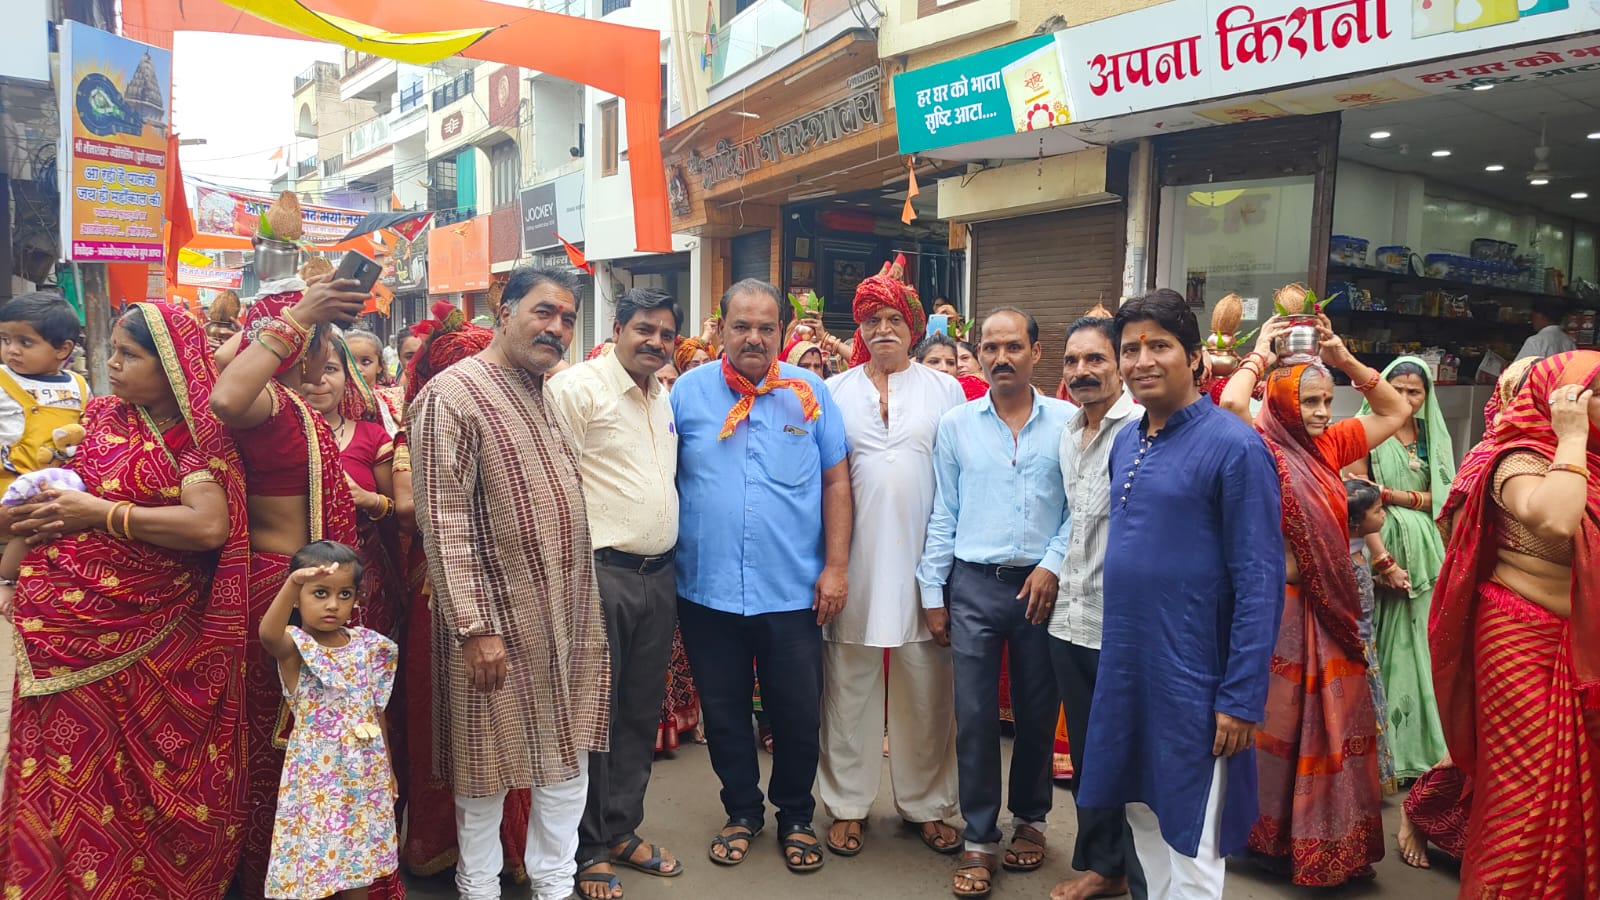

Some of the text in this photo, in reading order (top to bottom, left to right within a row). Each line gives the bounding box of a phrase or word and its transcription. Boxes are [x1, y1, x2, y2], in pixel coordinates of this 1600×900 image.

[1087, 0, 1393, 97] अपना किराना
[1416, 70, 1461, 84] हर
[1459, 61, 1510, 76] घर
[1507, 51, 1566, 68] को
[916, 71, 1001, 108] हर घर को भाता
[776, 84, 884, 154] वस्त्रालय
[924, 105, 952, 135] सृष्टि
[85, 167, 99, 180] आ
[101, 165, 116, 183] रही
[128, 170, 156, 187] पालकी
[77, 187, 97, 200] जय
[98, 185, 109, 203] हो
[148, 191, 161, 207] की
[320, 211, 342, 225] भयो
[525, 202, 554, 222] JOCKEY
